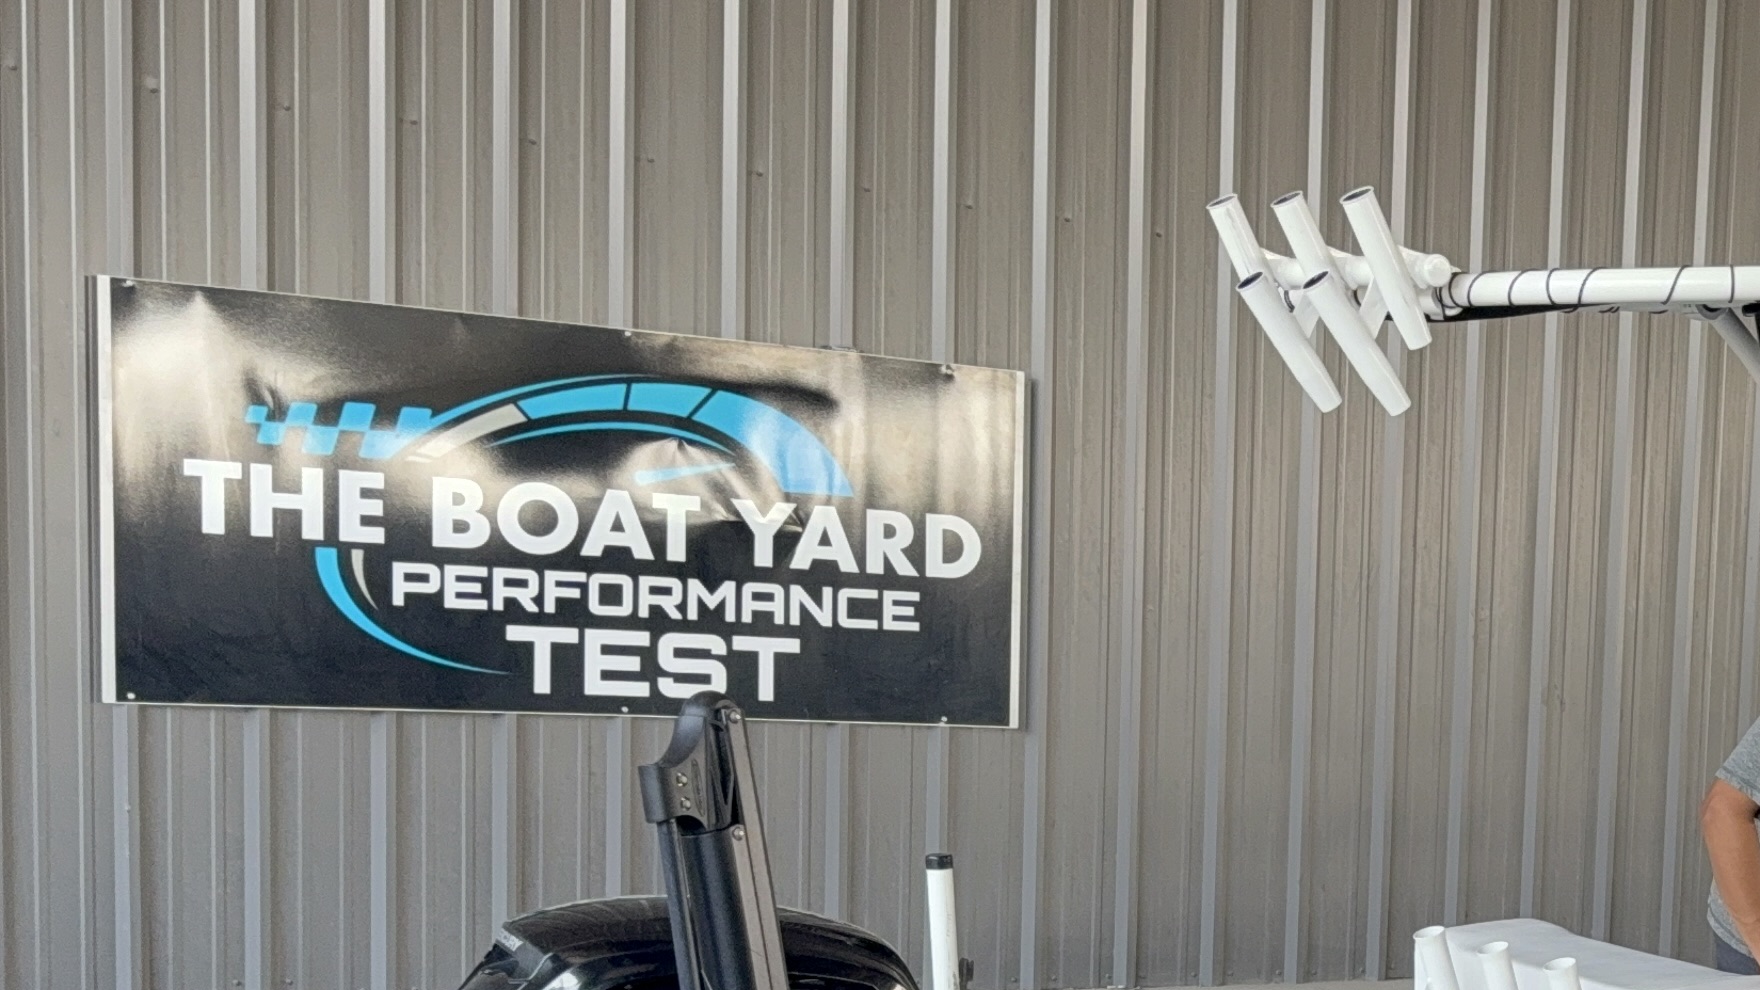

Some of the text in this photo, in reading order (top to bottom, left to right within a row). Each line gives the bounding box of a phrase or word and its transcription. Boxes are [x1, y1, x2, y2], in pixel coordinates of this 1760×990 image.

[183, 458, 983, 579] THE BOAT YARD
[391, 561, 922, 632] PERFORMANCE
[505, 625, 801, 702] TEST
